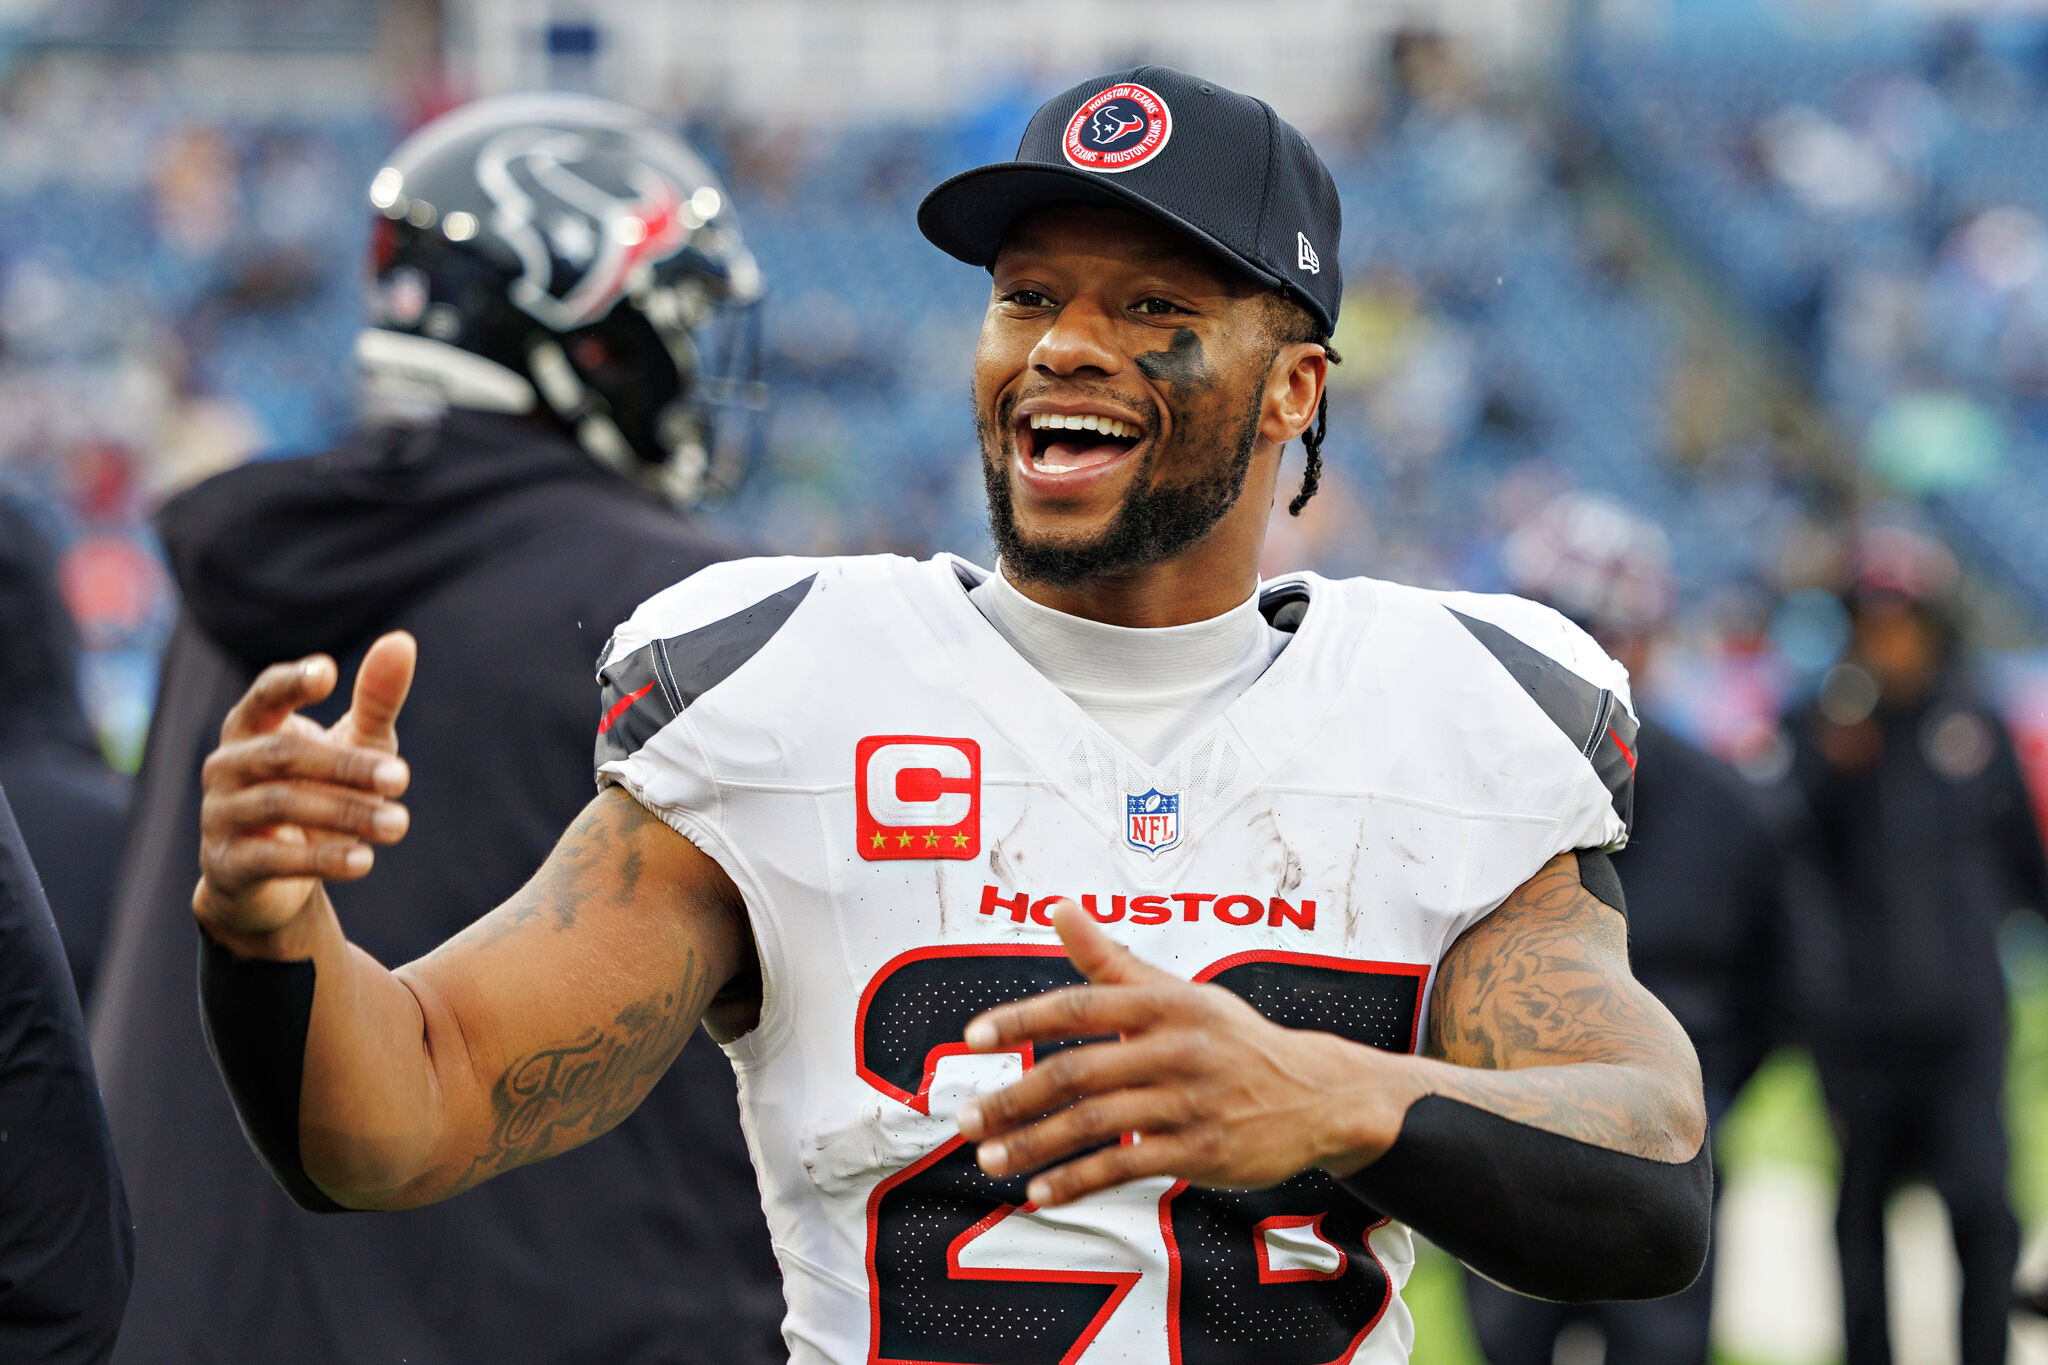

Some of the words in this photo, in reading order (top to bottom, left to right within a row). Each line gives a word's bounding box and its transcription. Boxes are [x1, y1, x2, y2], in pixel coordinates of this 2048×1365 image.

[1088, 88, 1130, 112] HOUSTON
[1130, 88, 1159, 114] TEXANS
[1071, 144, 1098, 162] TEXANS
[1103, 145, 1148, 163] HOUSTON
[1143, 119, 1162, 147] TEXANS
[866, 744, 972, 827] C
[1132, 815, 1174, 846] NFL
